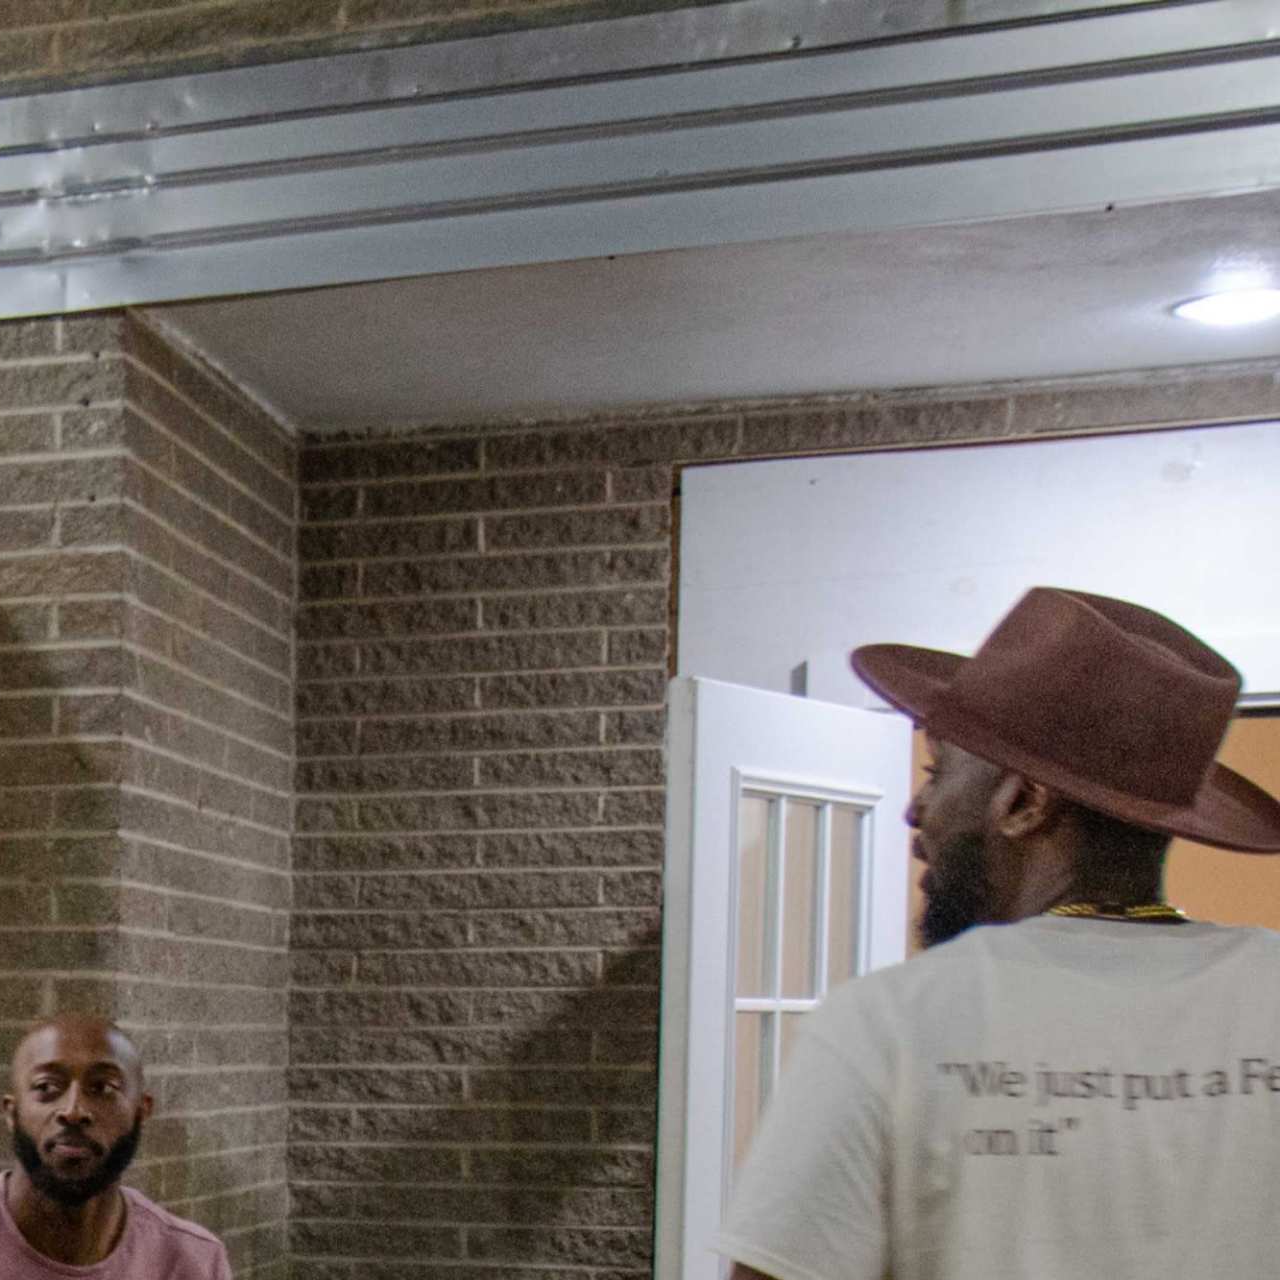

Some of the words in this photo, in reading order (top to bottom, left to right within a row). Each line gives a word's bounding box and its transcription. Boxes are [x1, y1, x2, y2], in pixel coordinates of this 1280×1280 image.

[1035, 1062, 1116, 1106] just
[1122, 1067, 1193, 1111] put
[1200, 1069, 1232, 1097] a
[961, 1129, 1020, 1156] on
